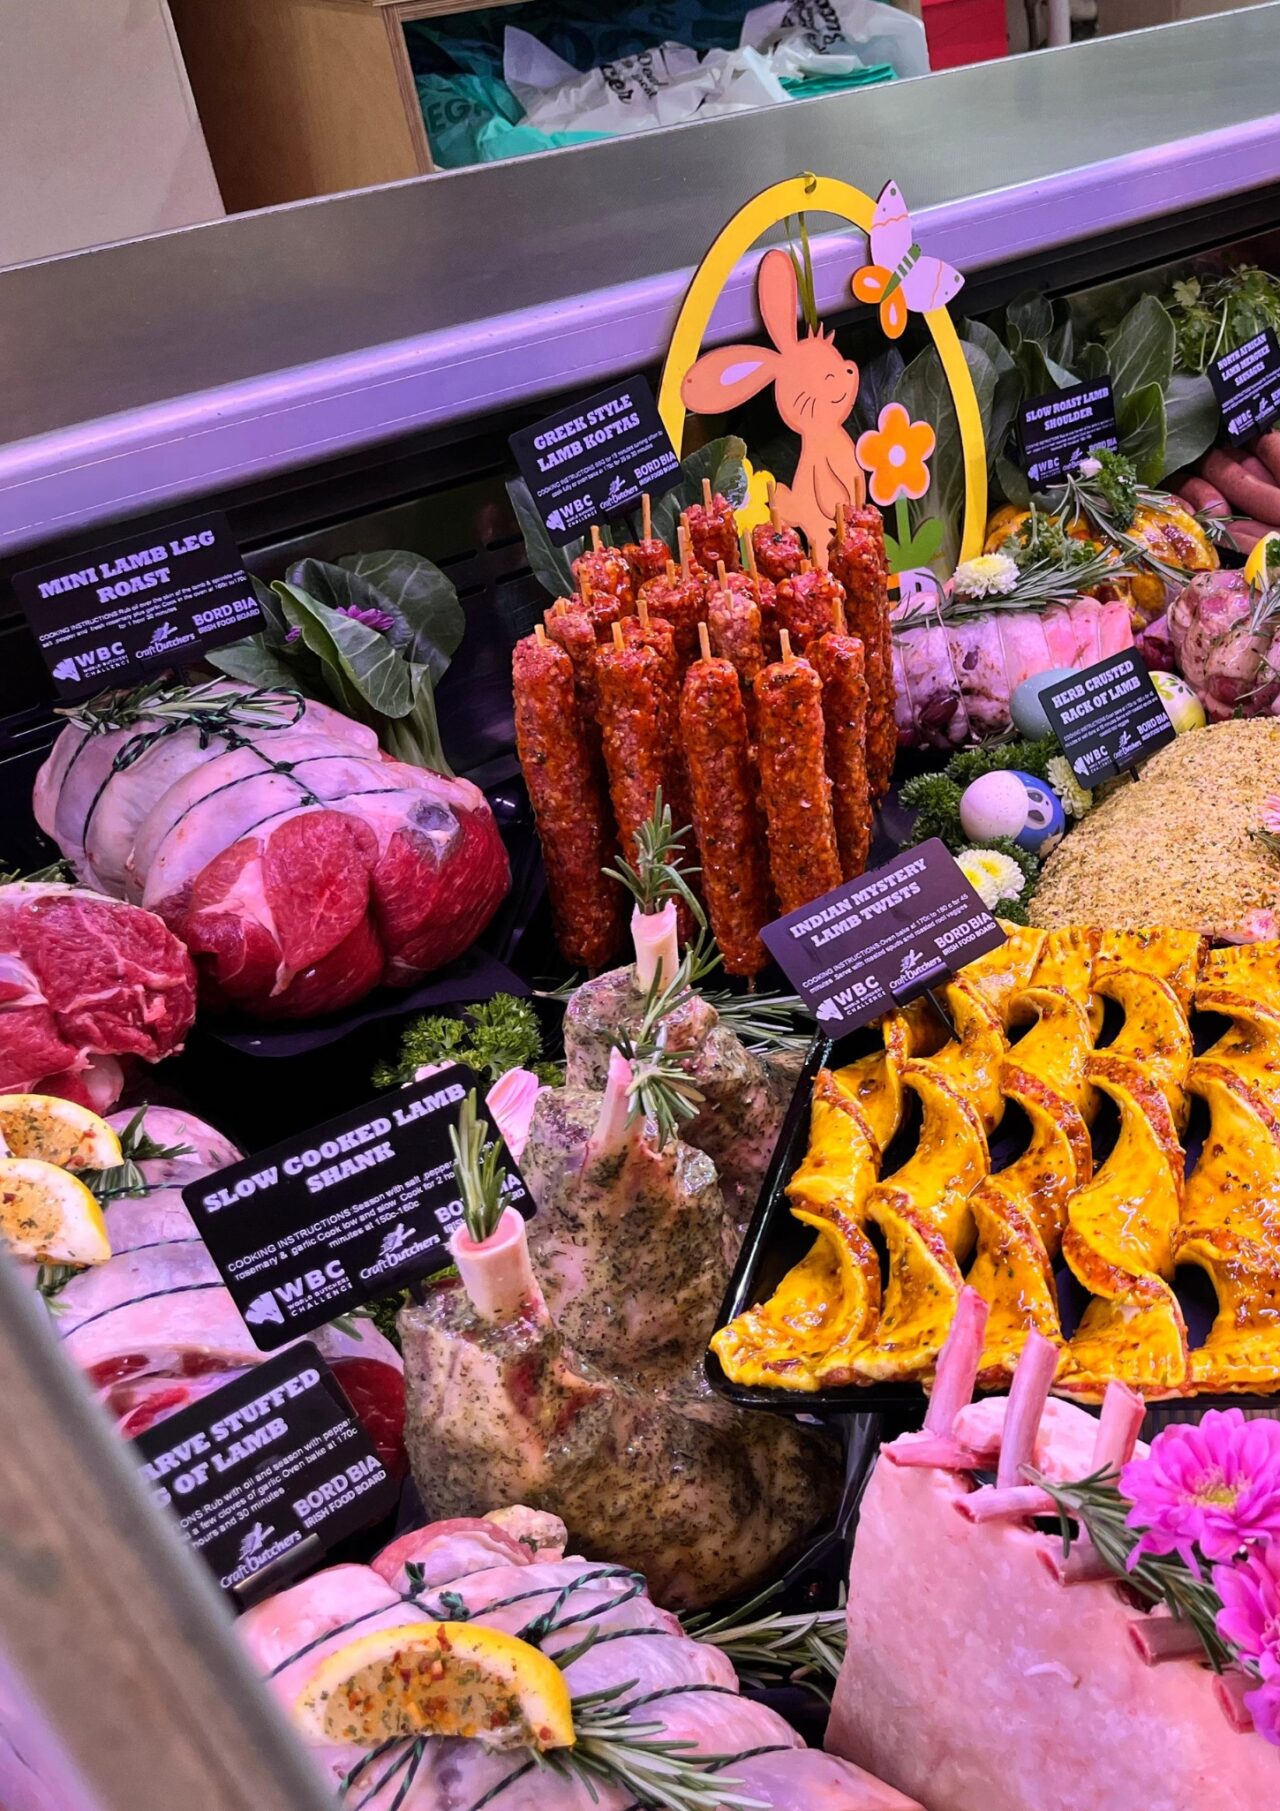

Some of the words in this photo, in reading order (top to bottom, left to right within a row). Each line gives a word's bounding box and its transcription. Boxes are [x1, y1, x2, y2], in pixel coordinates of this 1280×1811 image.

[1222, 363, 1241, 381] LAMB
[534, 416, 588, 450] GREEK
[587, 394, 633, 425] STYLE
[1026, 405, 1052, 422] SLOW
[1052, 395, 1082, 414] ROAST
[1083, 387, 1109, 404] LAMB
[1044, 407, 1093, 430] SHOULDER
[537, 441, 583, 472] LAMB
[583, 412, 640, 449] KOFTAS
[634, 459, 661, 479] BORD
[659, 451, 676, 466] BIA
[1037, 457, 1059, 474] WBC
[559, 494, 593, 518] WBC
[38, 567, 99, 598] MINI
[99, 546, 168, 579] LAMB
[169, 530, 215, 556] LEG
[96, 567, 170, 603] ROAST
[192, 605, 233, 626] BORD
[232, 597, 258, 613] BIA
[74, 642, 125, 667] WBC
[1051, 684, 1085, 709] HERB
[1085, 660, 1134, 692] CRUSTED
[1060, 700, 1094, 725] RACK
[1093, 691, 1108, 708] OF
[1108, 676, 1141, 700] LAMB
[1136, 718, 1157, 735] BORD
[1155, 712, 1168, 725] BIA
[1082, 745, 1108, 765] WBC
[789, 898, 853, 938] INDIAN
[850, 858, 927, 905] MYSTERY
[811, 914, 862, 947] LAMB
[859, 881, 921, 920] TWISTS
[934, 923, 970, 948] BORD
[967, 912, 992, 929] BIA
[958, 933, 976, 946] FOOD
[974, 922, 996, 937] BOARD
[833, 975, 879, 1005] WBC
[203, 1166, 278, 1213] SLOW
[283, 1118, 391, 1175] COOKED
[392, 1083, 466, 1126] LAMB
[306, 1141, 395, 1193] SHANK
[228, 1244, 277, 1272] COOKING
[385, 1184, 405, 1197] with
[404, 1176, 421, 1188] salt
[235, 1256, 278, 1280] rosemary
[279, 1251, 288, 1260] &
[291, 1238, 317, 1256] garlic
[316, 1226, 342, 1241] Cook
[341, 1218, 358, 1230] low
[359, 1208, 376, 1222] and
[399, 1187, 423, 1201] Cook
[422, 1180, 435, 1190] for
[435, 1176, 443, 1184] 2
[328, 1227, 364, 1248] minutes
[364, 1222, 374, 1231] at
[275, 1260, 345, 1303] WBC
[210, 1369, 320, 1441] STUFFED
[173, 1462, 209, 1494] OF
[211, 1417, 288, 1472] LAMB
[199, 1516, 217, 1529] few
[218, 1498, 247, 1519] cloves
[247, 1489, 256, 1500] of
[257, 1475, 282, 1496] garlic
[281, 1461, 305, 1478] Oven
[305, 1447, 326, 1464] bake
[327, 1440, 337, 1450] at
[336, 1428, 358, 1443] 170c
[223, 1486, 243, 1501] with
[242, 1478, 255, 1489] oil
[255, 1466, 273, 1482] and
[272, 1448, 304, 1471] season
[303, 1437, 322, 1451] with
[322, 1418, 350, 1441] pepper
[292, 1474, 348, 1518] BORD
[345, 1455, 382, 1483] BIA
[303, 1507, 330, 1528] IRISH
[328, 1490, 355, 1512] FOOD
[354, 1470, 386, 1495] BOARD
[190, 1529, 219, 1550] hours
[219, 1516, 237, 1532] and
[236, 1508, 250, 1520] 30
[250, 1487, 285, 1512] minutes
